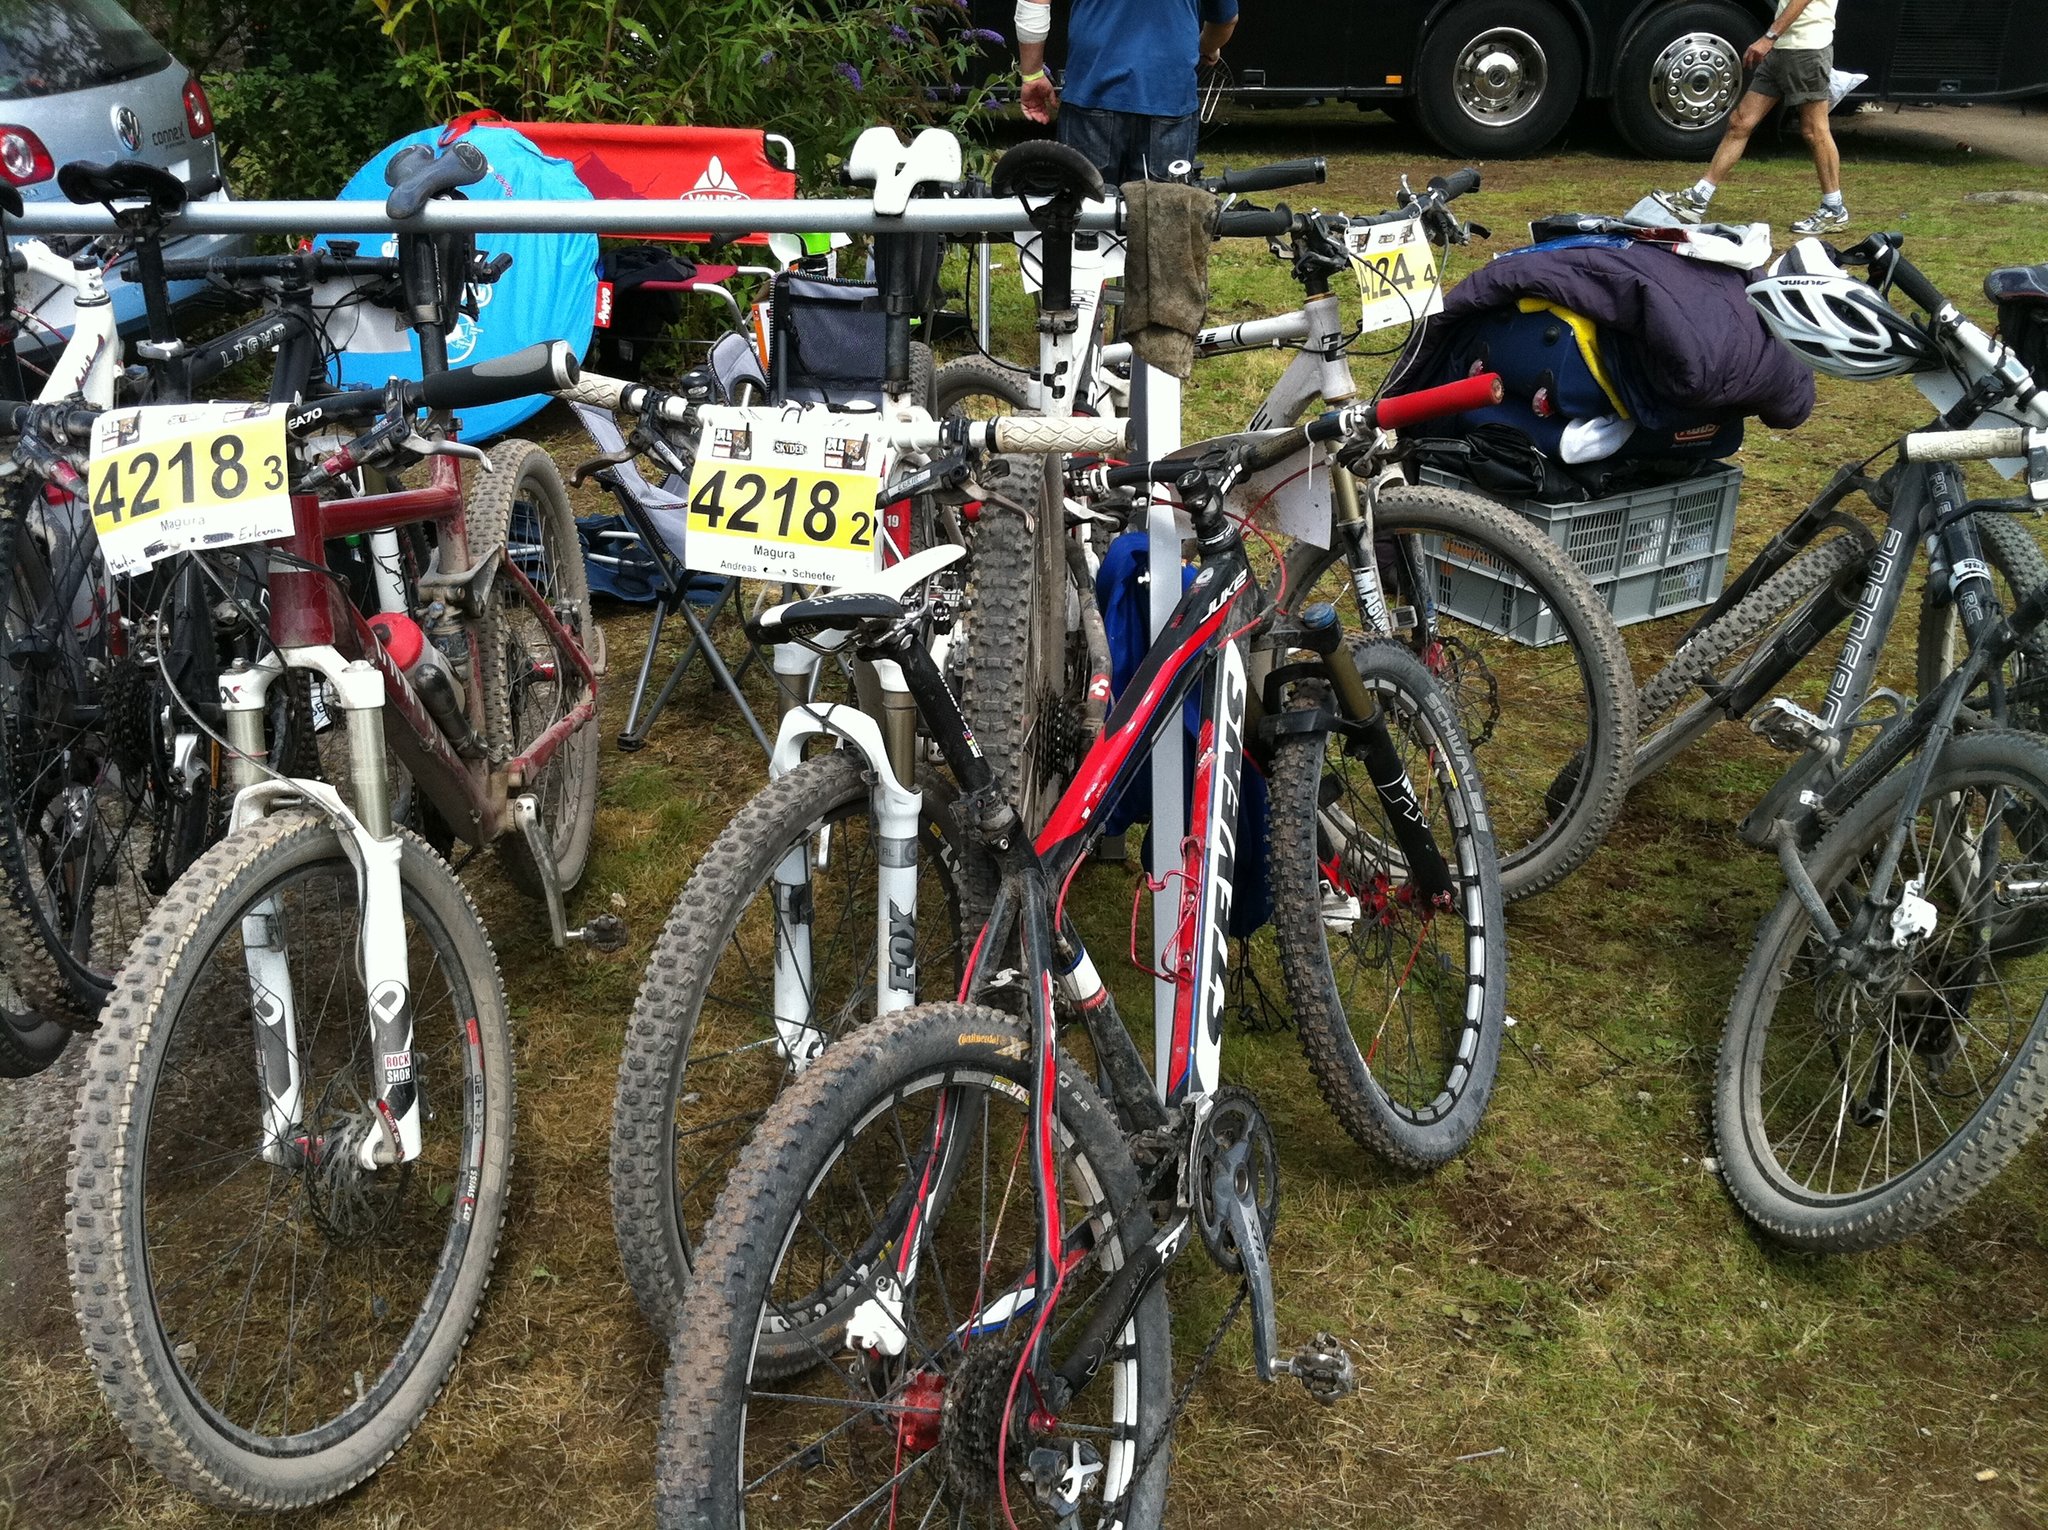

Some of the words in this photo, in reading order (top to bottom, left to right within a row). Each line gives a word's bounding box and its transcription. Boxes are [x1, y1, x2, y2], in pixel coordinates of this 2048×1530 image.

[1423, 264, 1438, 285] 4
[220, 323, 287, 368] LIGHT
[288, 407, 323, 430] EA70
[774, 440, 806, 456] SKYDER
[92, 434, 249, 524] 4218
[263, 455, 285, 491] 3
[690, 469, 841, 542] 4218
[849, 511, 871, 546] 2
[886, 514, 900, 528] 19
[753, 544, 796, 560] Magura
[720, 560, 758, 573] Andreas
[1199, 568, 1248, 625] JUKE
[1424, 692, 1489, 832] SCHWALBE
[888, 895, 917, 995] FOX
[384, 1053, 411, 1069] ROCK
[386, 1068, 412, 1084] SHOX
[467, 1169, 479, 1198] SWISS
[462, 1203, 473, 1222] DT
